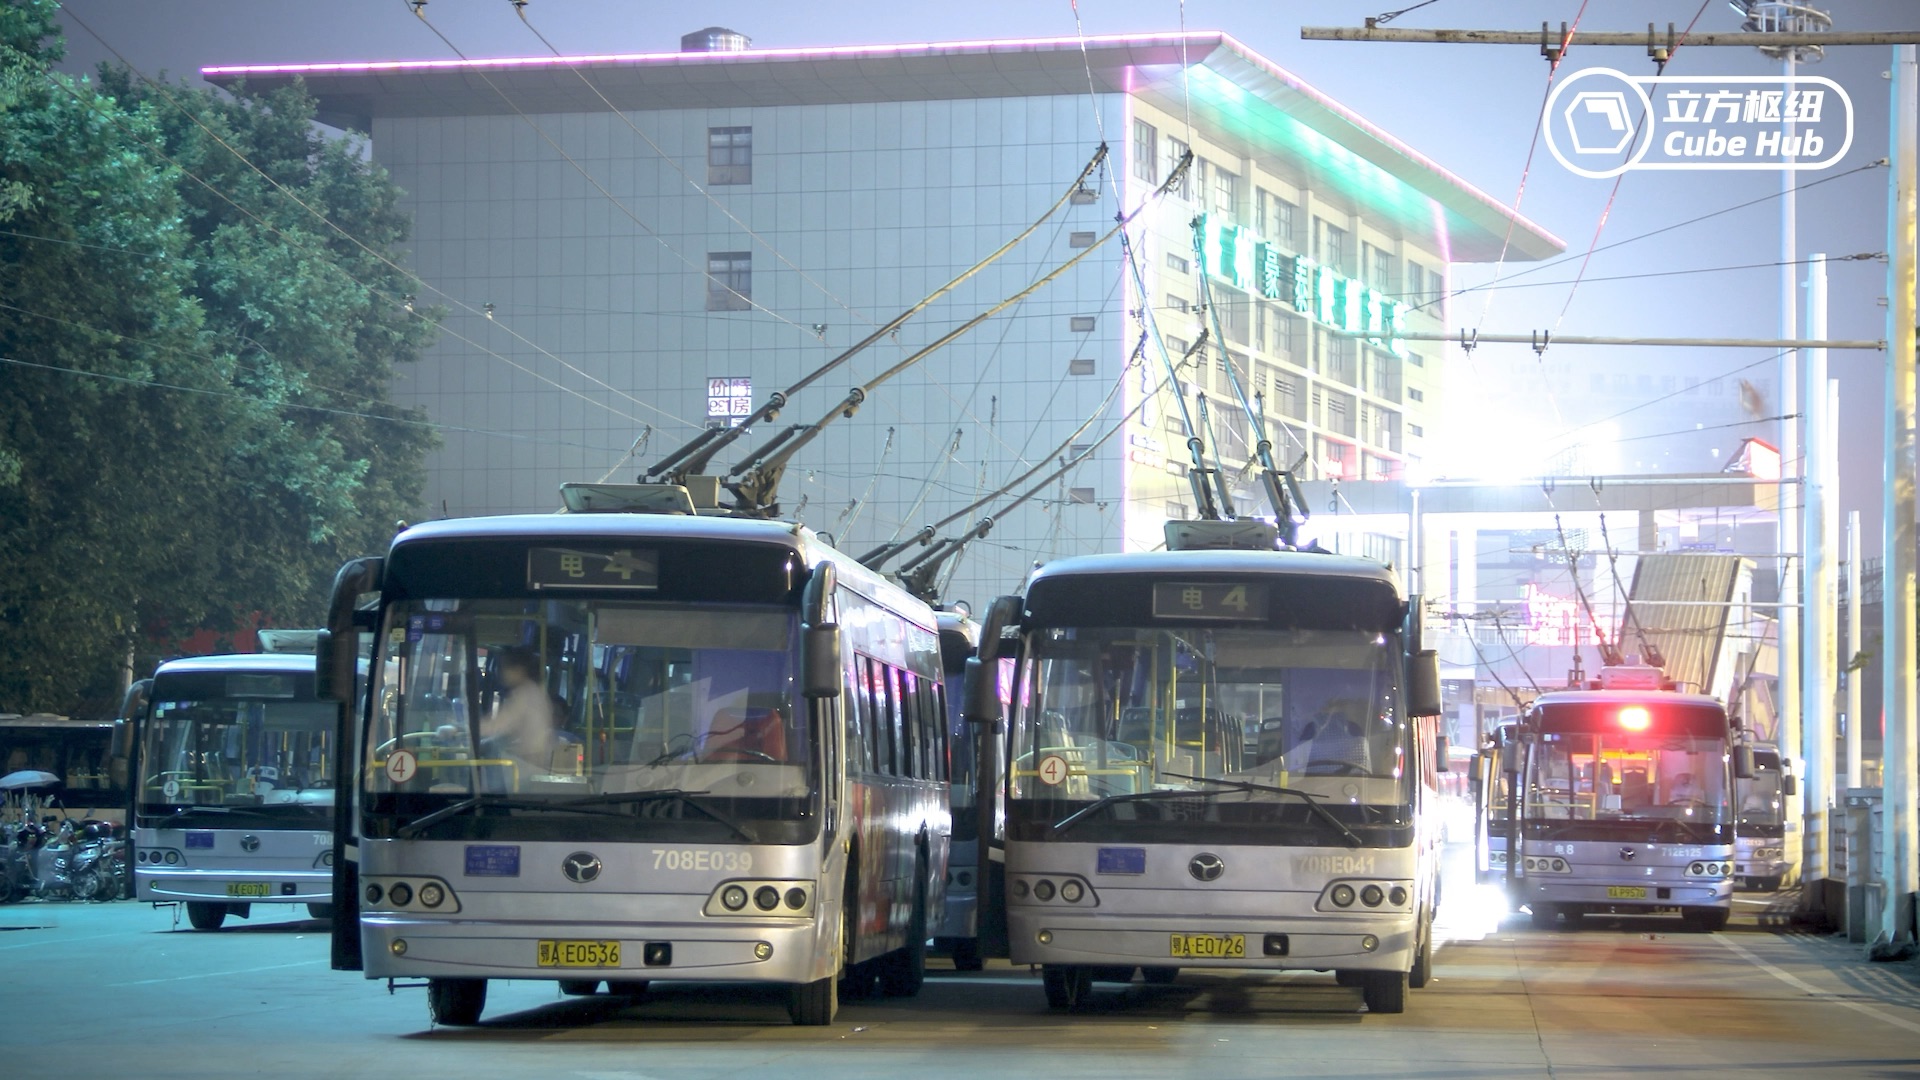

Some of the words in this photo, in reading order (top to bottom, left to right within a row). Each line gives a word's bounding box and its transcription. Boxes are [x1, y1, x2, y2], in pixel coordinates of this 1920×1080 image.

[561, 554, 585, 577] 电
[603, 549, 633, 580] 4
[1183, 588, 1203, 610] 电
[1221, 585, 1249, 611] 4
[392, 756, 406, 778] 4
[1046, 760, 1058, 781] 4
[652, 847, 753, 873] 708E039
[1662, 847, 1702, 857] 712E125
[1296, 855, 1375, 874] 708E041
